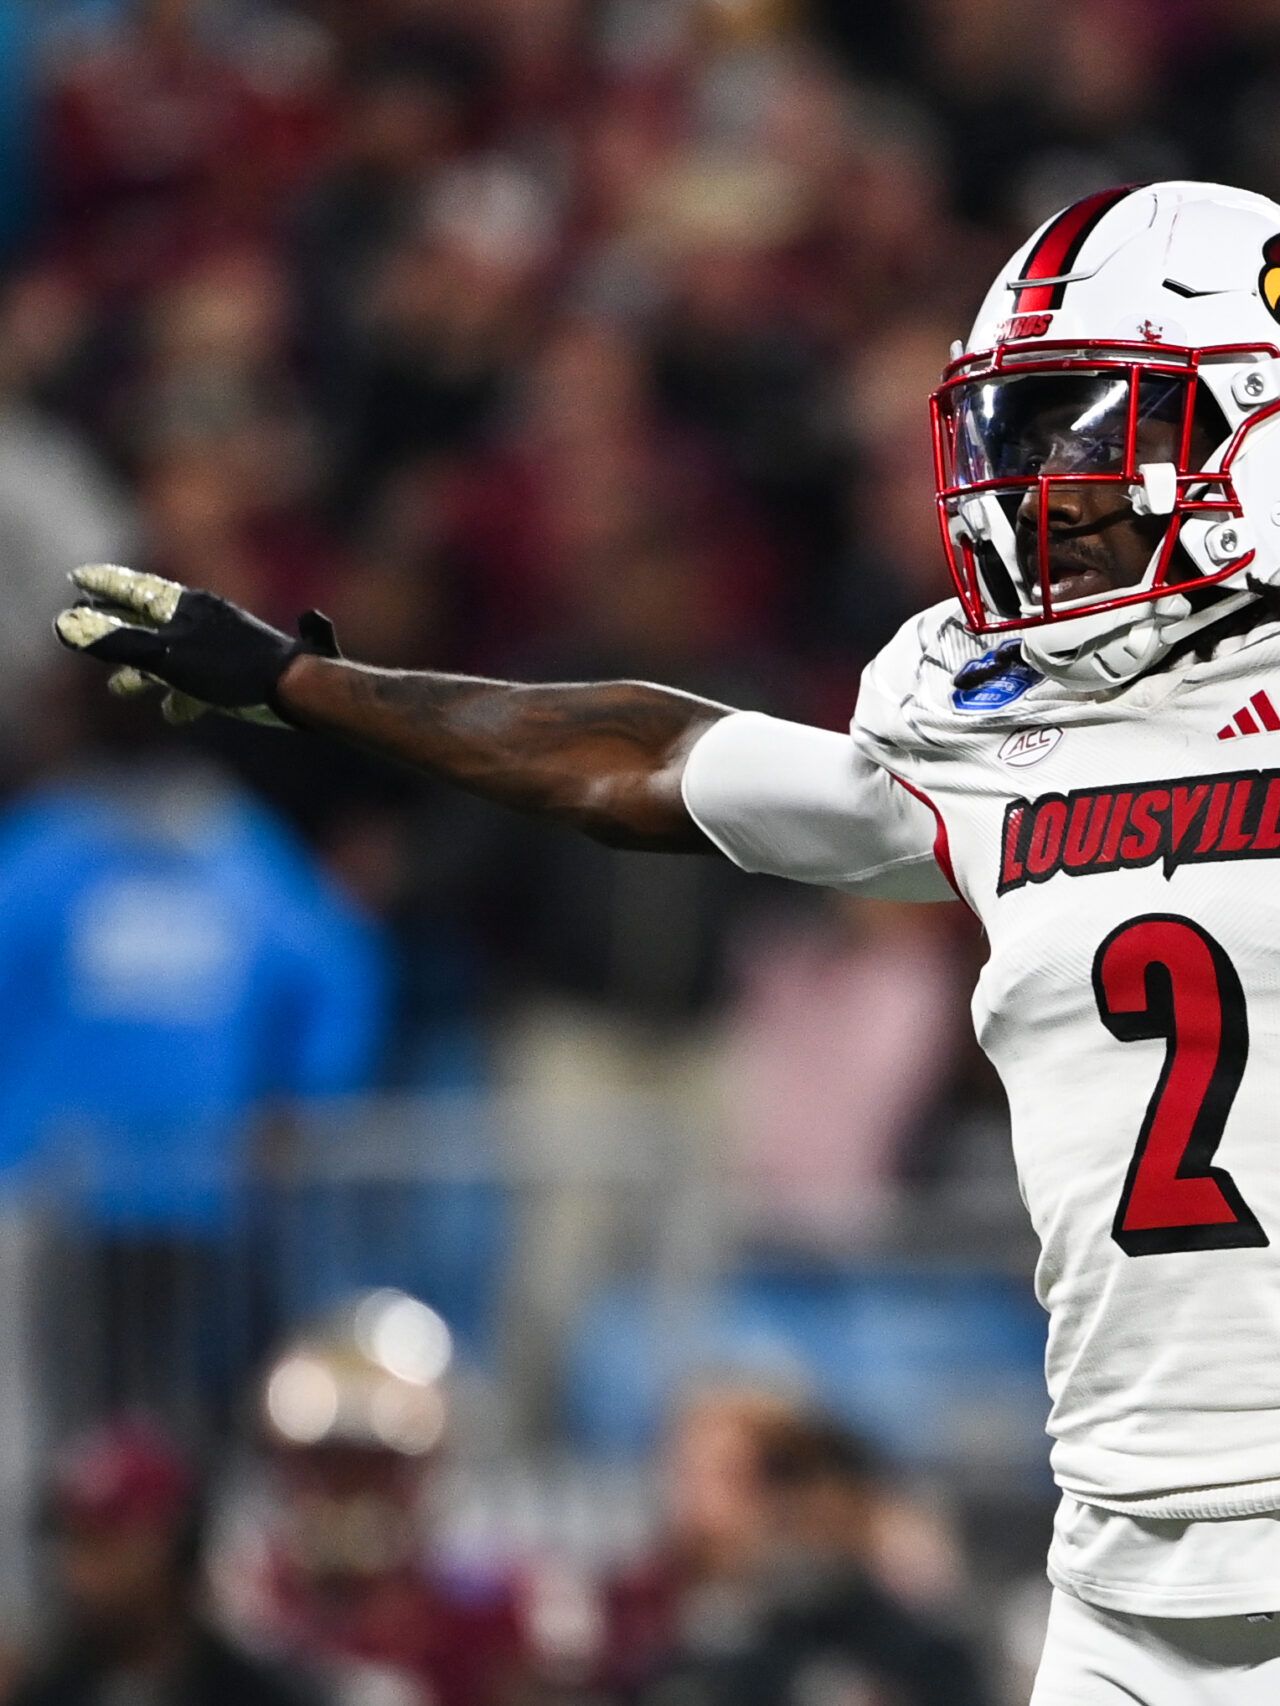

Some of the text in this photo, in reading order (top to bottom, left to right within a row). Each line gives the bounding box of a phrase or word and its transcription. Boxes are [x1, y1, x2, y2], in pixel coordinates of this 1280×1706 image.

[995, 313, 1054, 343] ARDS
[1008, 727, 1051, 755] ACC
[1091, 912, 1270, 1257] 2
